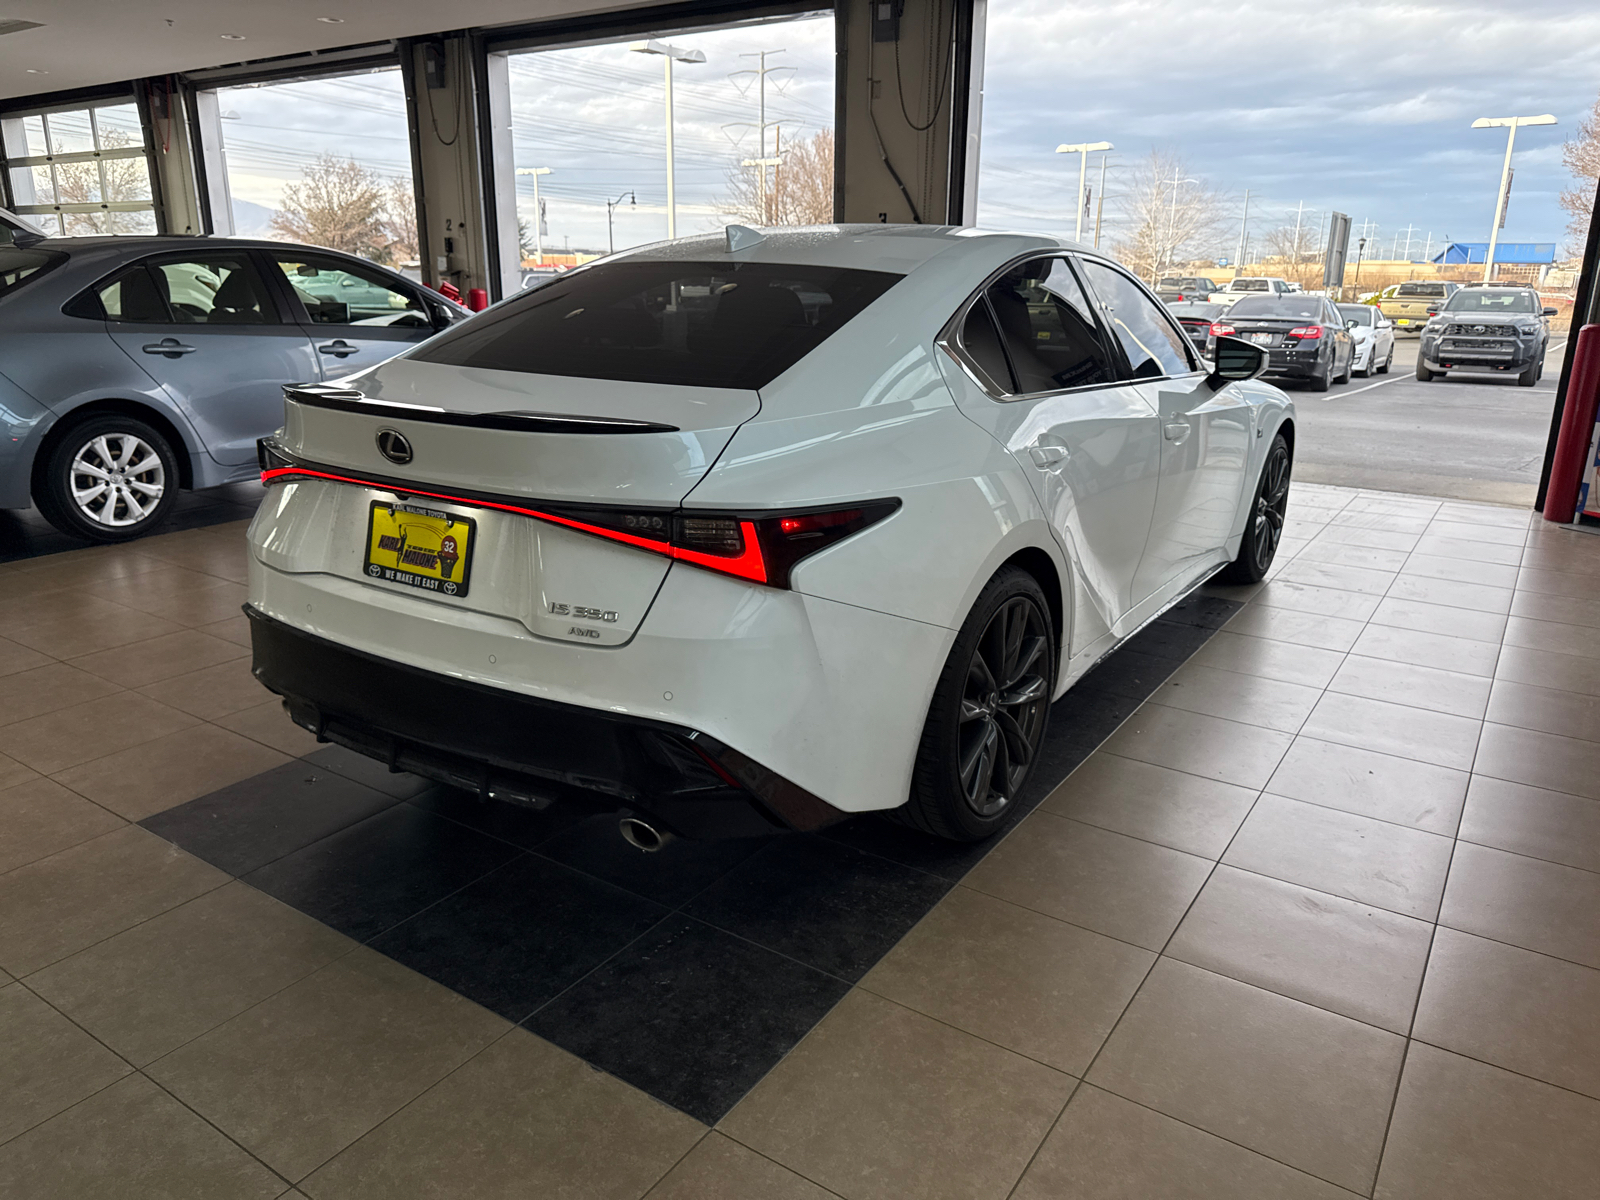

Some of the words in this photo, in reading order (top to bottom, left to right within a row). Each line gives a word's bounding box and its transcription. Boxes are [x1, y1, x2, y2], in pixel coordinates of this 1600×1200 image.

[446, 219, 452, 231] 2
[392, 504, 406, 512] KARL
[406, 506, 427, 516] MALONE
[427, 510, 447, 519] TOYOTA
[378, 534, 400, 552] KARL
[444, 541, 455, 553] 32
[401, 549, 438, 570] MALONE
[385, 569, 395, 579] WE
[396, 571, 413, 584] MAKE
[414, 576, 421, 585] IT
[422, 578, 439, 590] EASY
[548, 602, 570, 615] IS
[572, 606, 619, 622] 350
[568, 627, 600, 638] AWD
